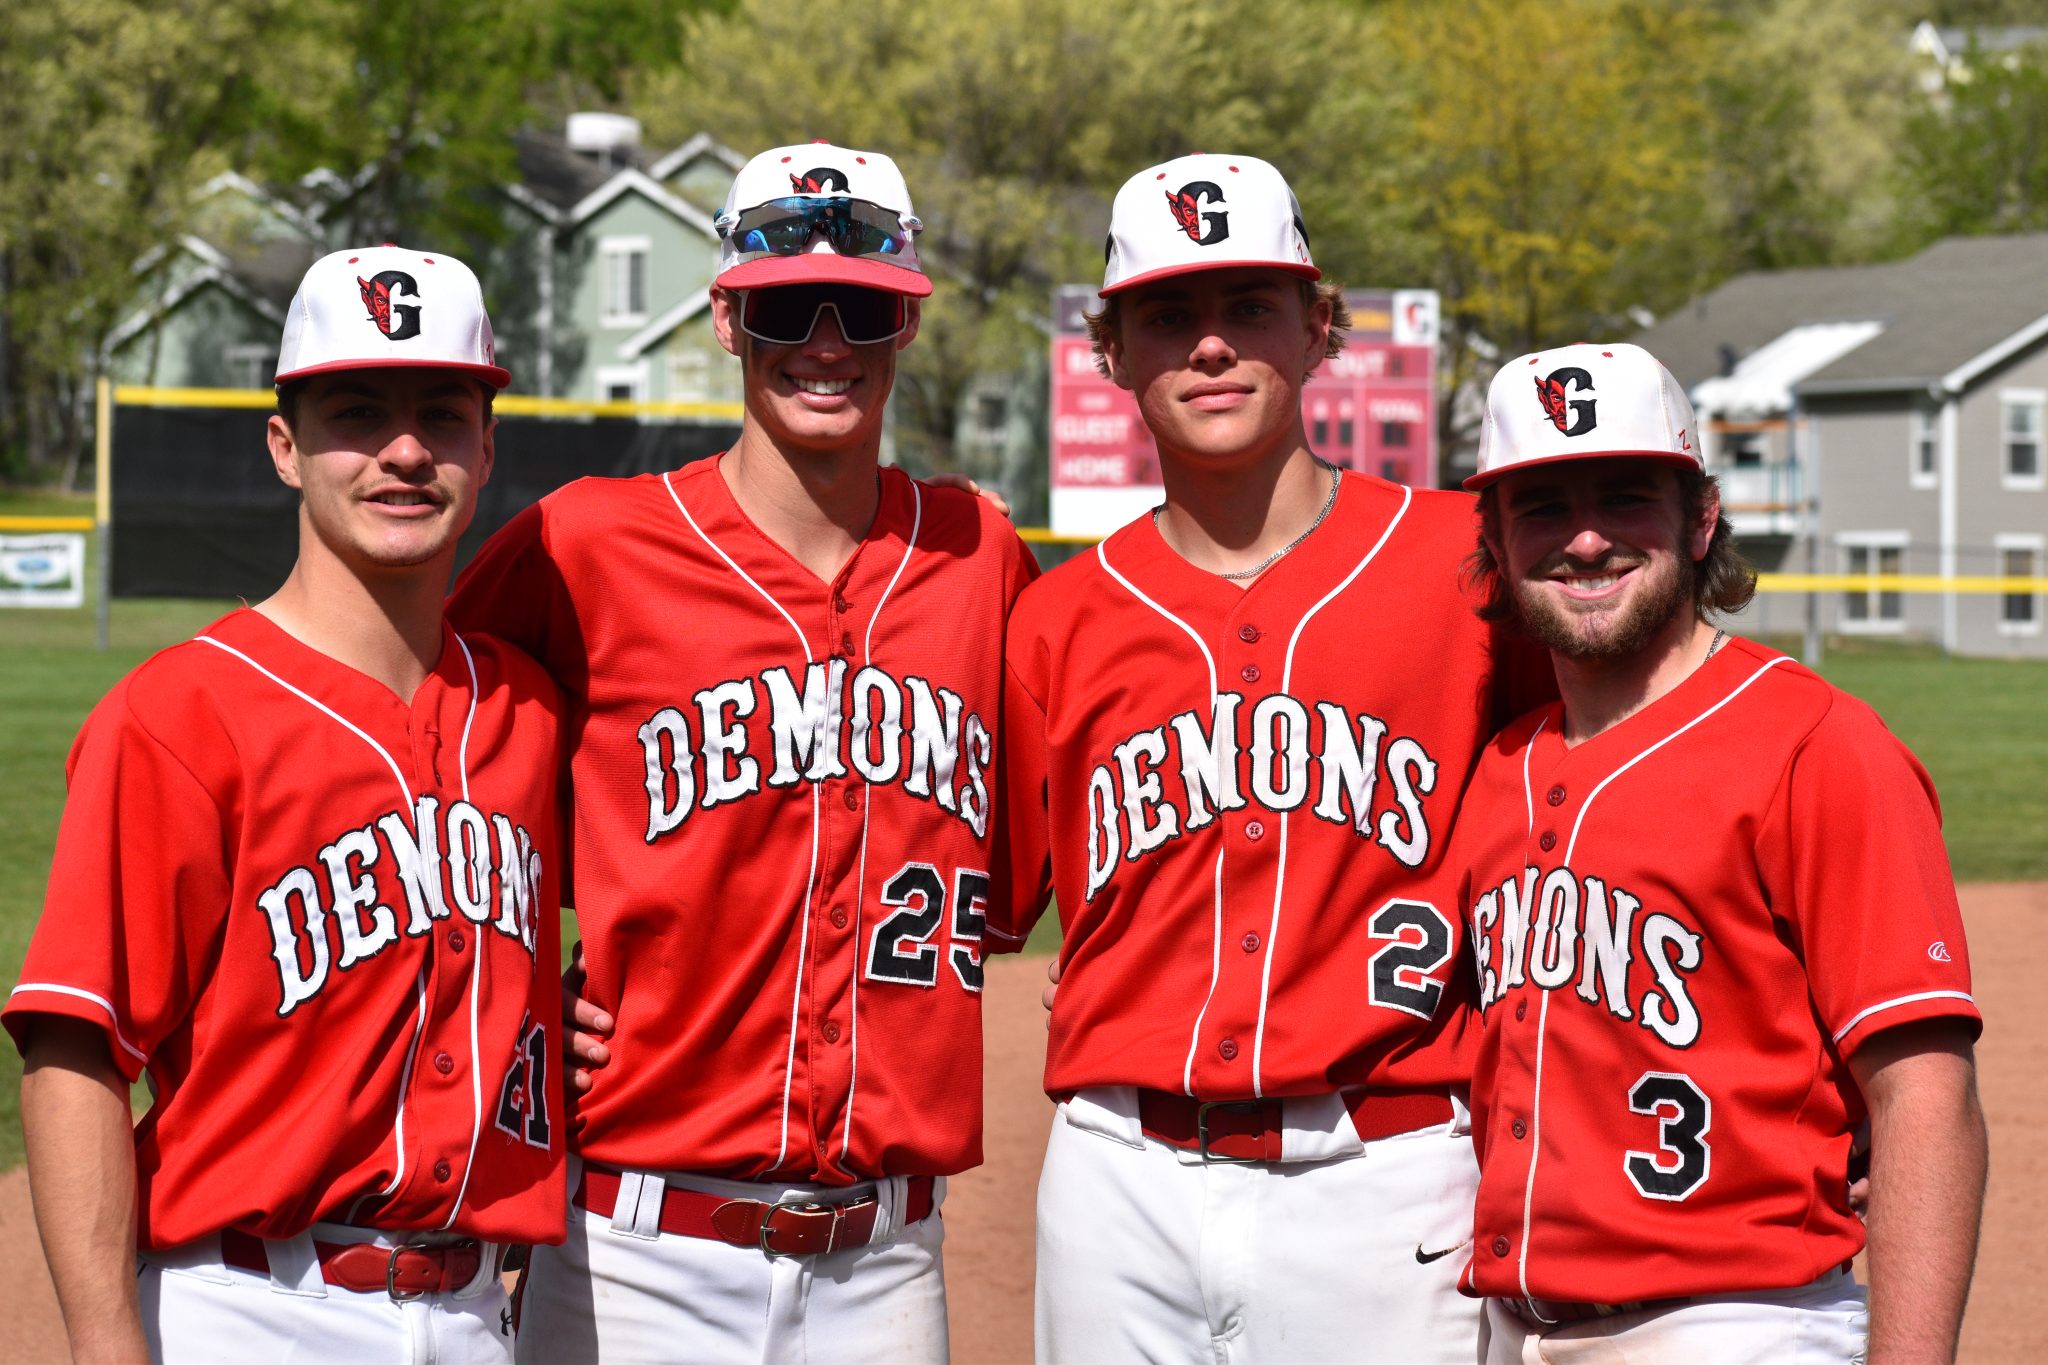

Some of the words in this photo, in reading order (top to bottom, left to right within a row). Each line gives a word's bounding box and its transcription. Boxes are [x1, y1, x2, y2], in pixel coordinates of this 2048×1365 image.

[1165, 181, 1230, 246] G
[357, 270, 423, 341] G
[1055, 415, 1129, 444] GUEST
[1534, 366, 1598, 437] G
[1061, 456, 1125, 483] HOME
[637, 655, 992, 843] DEMONS
[1086, 691, 1439, 905] DEMONS
[865, 861, 990, 992] 25
[1368, 898, 1453, 1021] 2
[1470, 866, 1704, 1050] EMONS
[1623, 1071, 1711, 1203] 3
